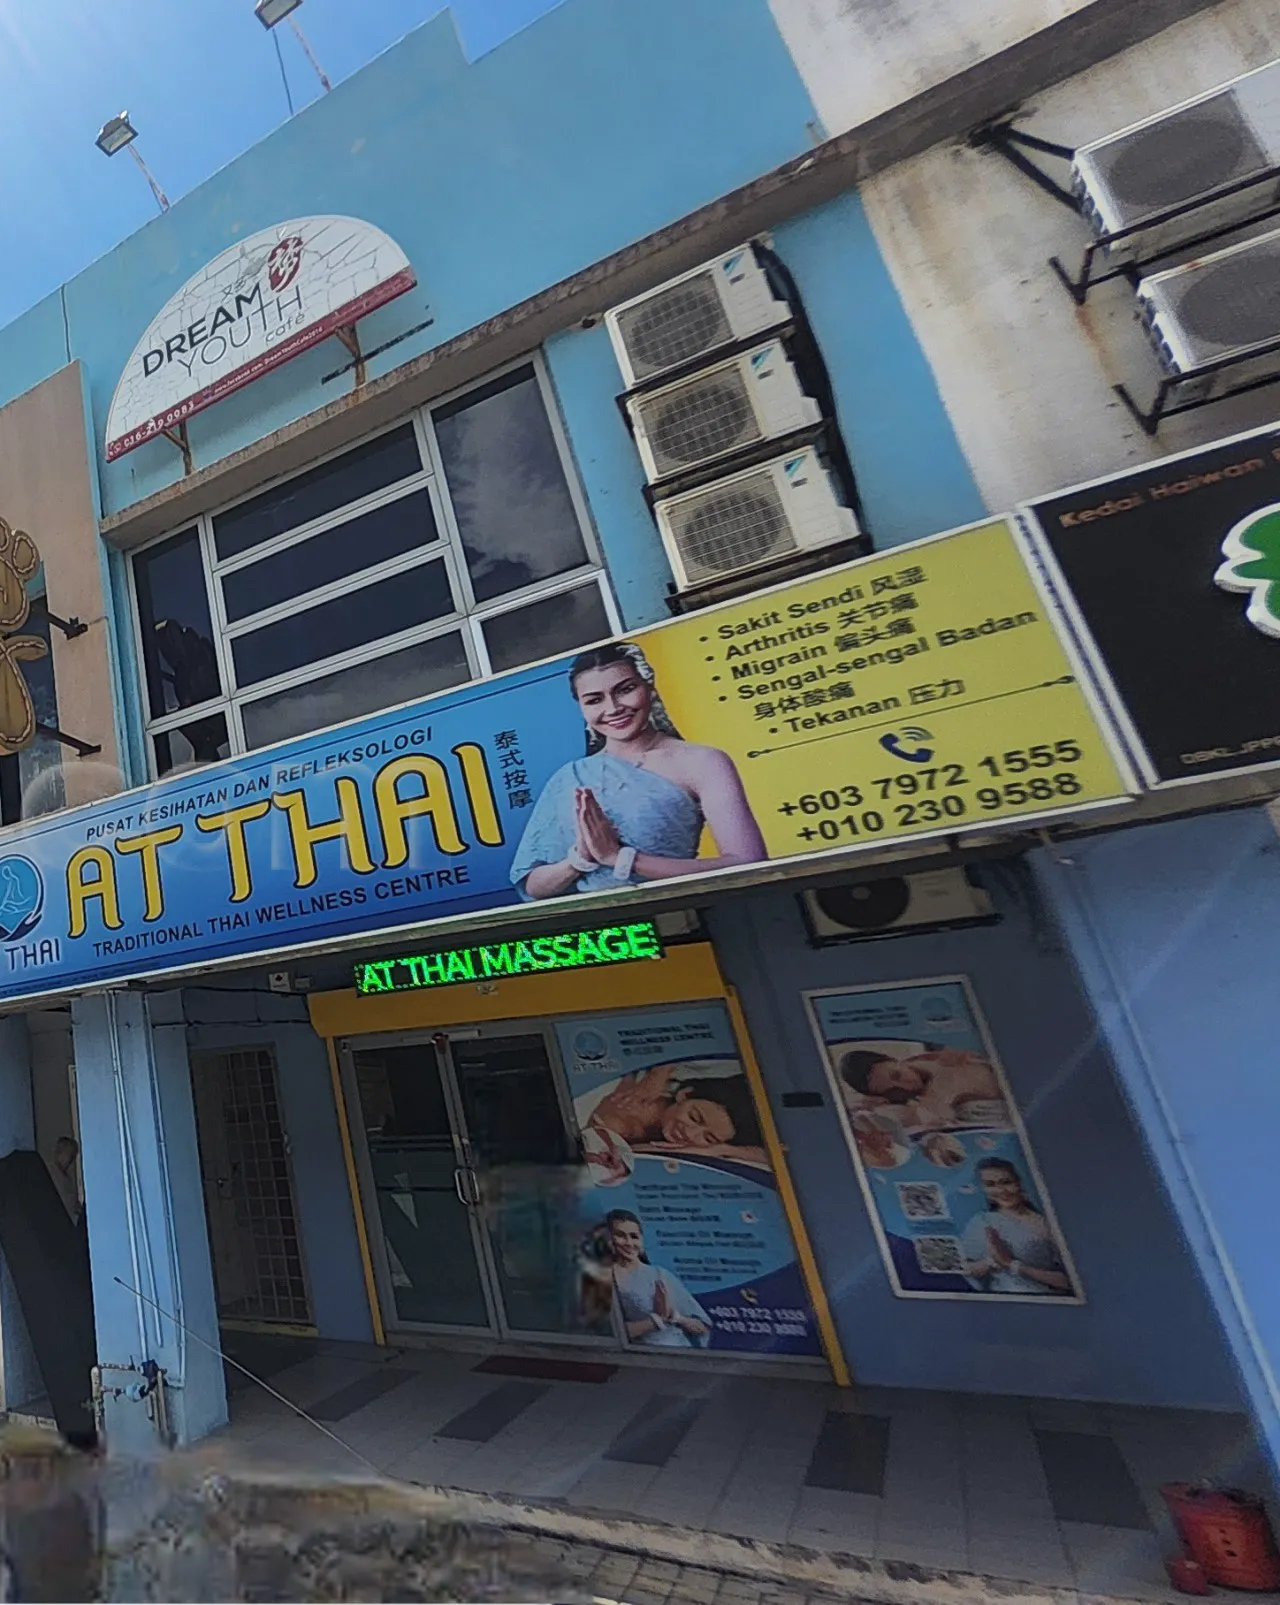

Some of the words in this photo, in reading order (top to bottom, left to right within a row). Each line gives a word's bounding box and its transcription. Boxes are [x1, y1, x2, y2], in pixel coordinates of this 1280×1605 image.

[142, 281, 263, 379] DREAM
[177, 284, 303, 378] YOUTH
[1058, 491, 1145, 529] Kedai
[1147, 456, 1268, 501] Haiwan
[718, 611, 783, 640] Sakit
[787, 584, 865, 619] Sendi
[725, 620, 831, 661] Arthritis
[837, 592, 920, 629] 关节痛
[730, 642, 828, 681] Migrain
[737, 636, 932, 701] Sengal-sengal
[936, 609, 1040, 649] Badan
[784, 696, 903, 734] Tekanan
[907, 677, 967, 707] 压力
[85, 814, 134, 842] PUSAT
[137, 786, 229, 828] KESIHATAN
[232, 774, 272, 803] DAN
[275, 726, 435, 788] REFLEKSOLOGI
[493, 729, 534, 810] 泰式按摩
[777, 784, 865, 820] +603
[872, 762, 967, 798] 7972
[982, 738, 1084, 779] 1555
[795, 808, 886, 845] +010
[898, 792, 967, 828] 230
[982, 771, 1084, 811] 9588
[65, 824, 183, 939] AT
[197, 741, 506, 905] THAI
[91, 922, 204, 958] TRADITIONAL
[207, 907, 252, 936] THAI
[254, 884, 368, 925] WELLNESS
[373, 864, 471, 902] CENTRE
[4, 938, 62, 972] THAI
[362, 960, 396, 993] AT
[397, 949, 477, 987] THAI
[479, 922, 660, 978] MASSAGE
